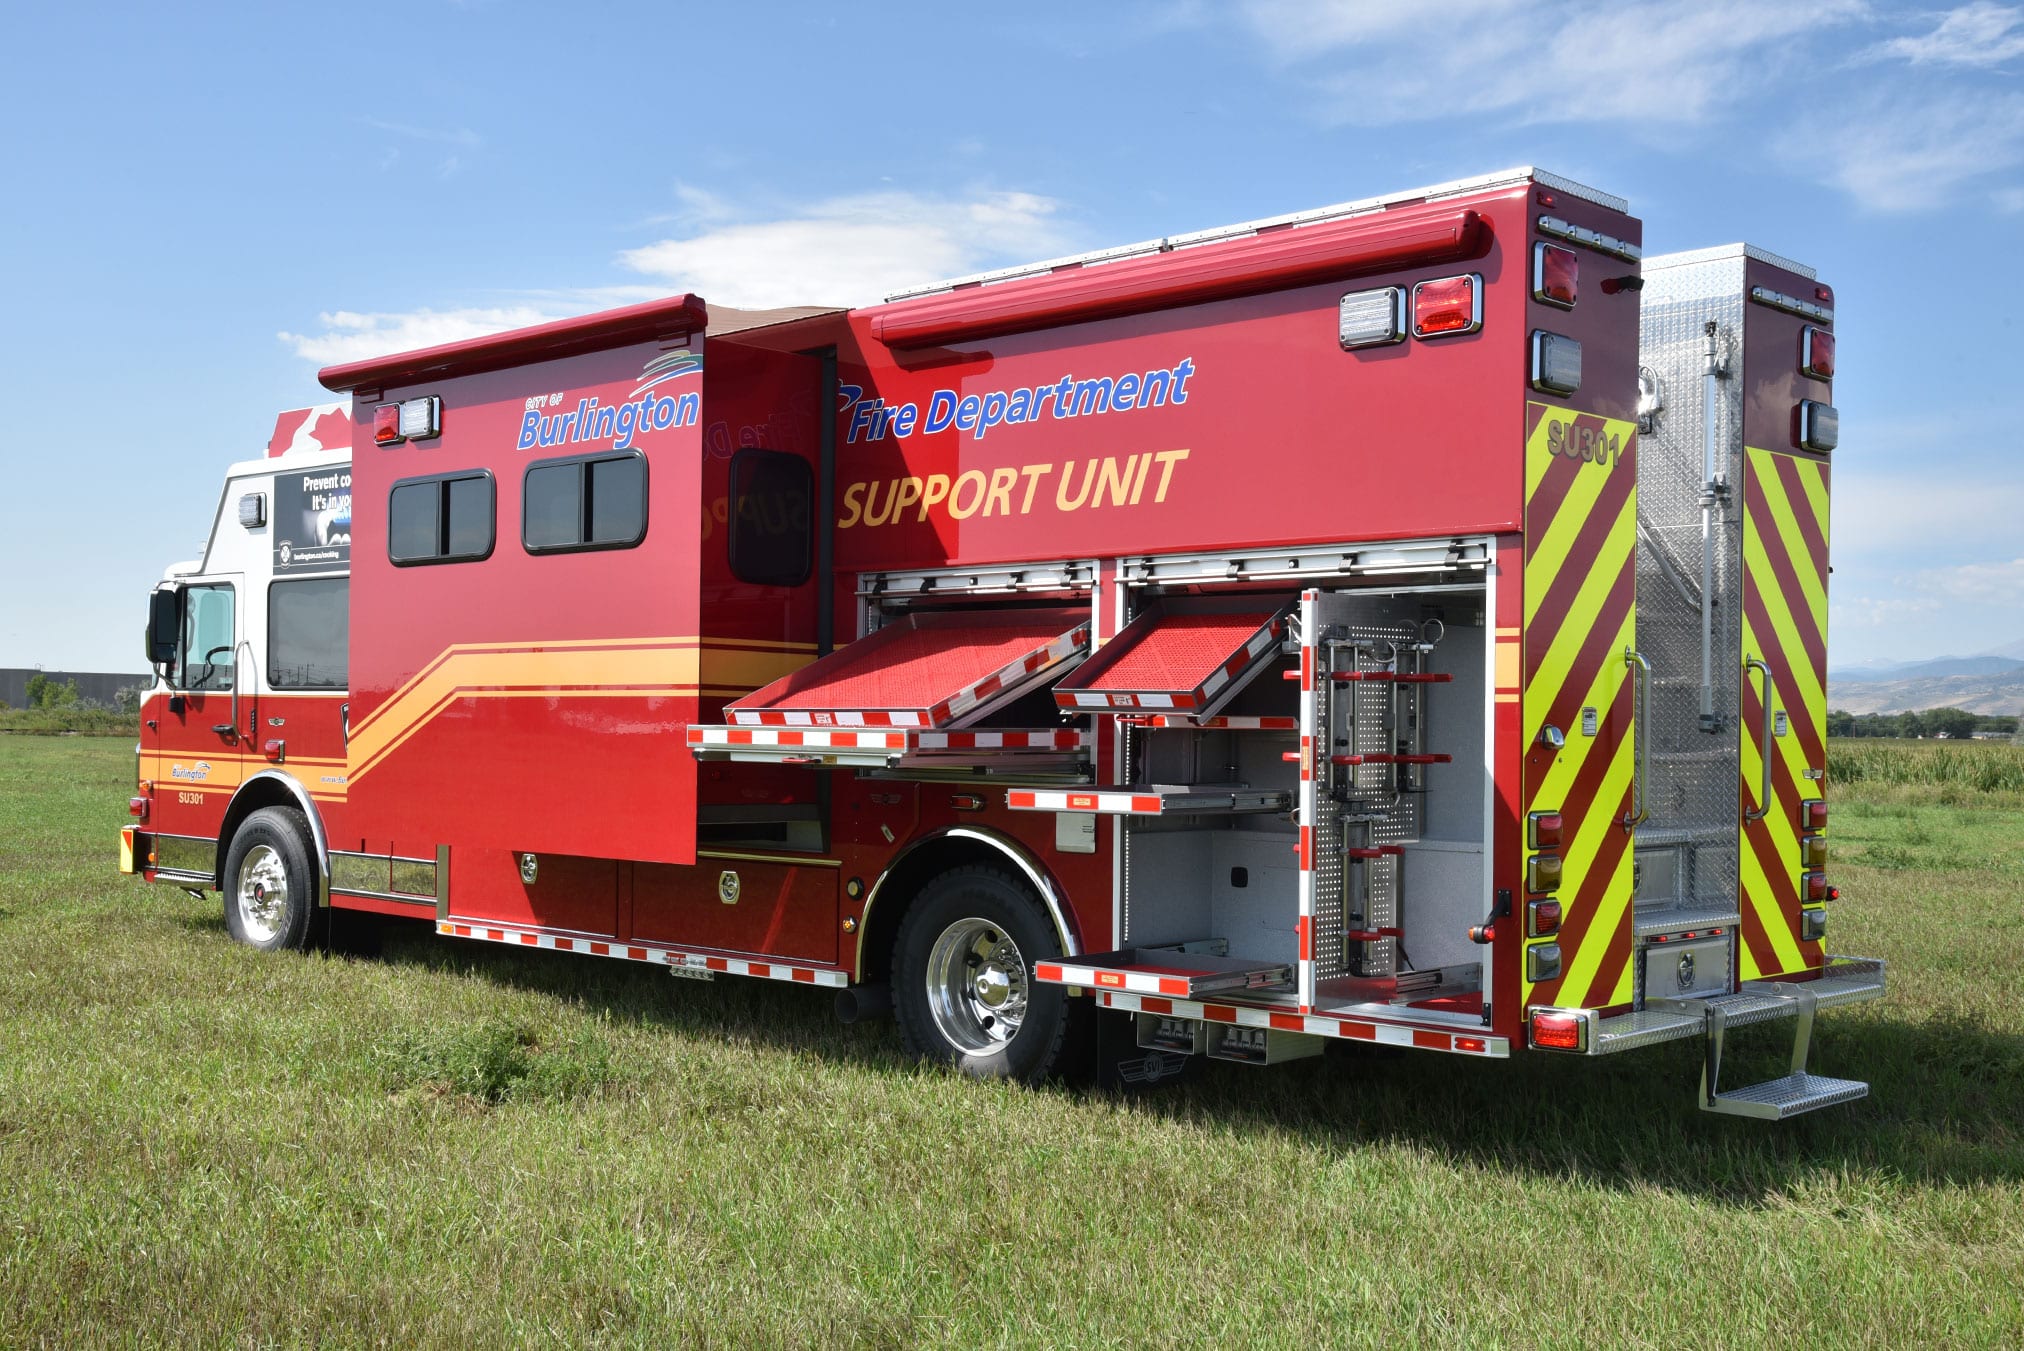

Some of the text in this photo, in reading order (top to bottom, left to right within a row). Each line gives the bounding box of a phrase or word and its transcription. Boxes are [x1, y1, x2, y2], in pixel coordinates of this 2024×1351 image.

[525, 393, 563, 410] CITY OF
[847, 356, 1195, 444] Fire Department
[516, 391, 700, 450] Burlington
[1547, 419, 1620, 467] SU301
[303, 473, 339, 492] Prevent
[838, 463, 1053, 530] SUPPORT
[1055, 449, 1190, 512] UNIT
[312, 494, 327, 511] It's
[328, 492, 337, 509] in
[172, 767, 206, 783] Burlington
[178, 791, 204, 805] SU301
